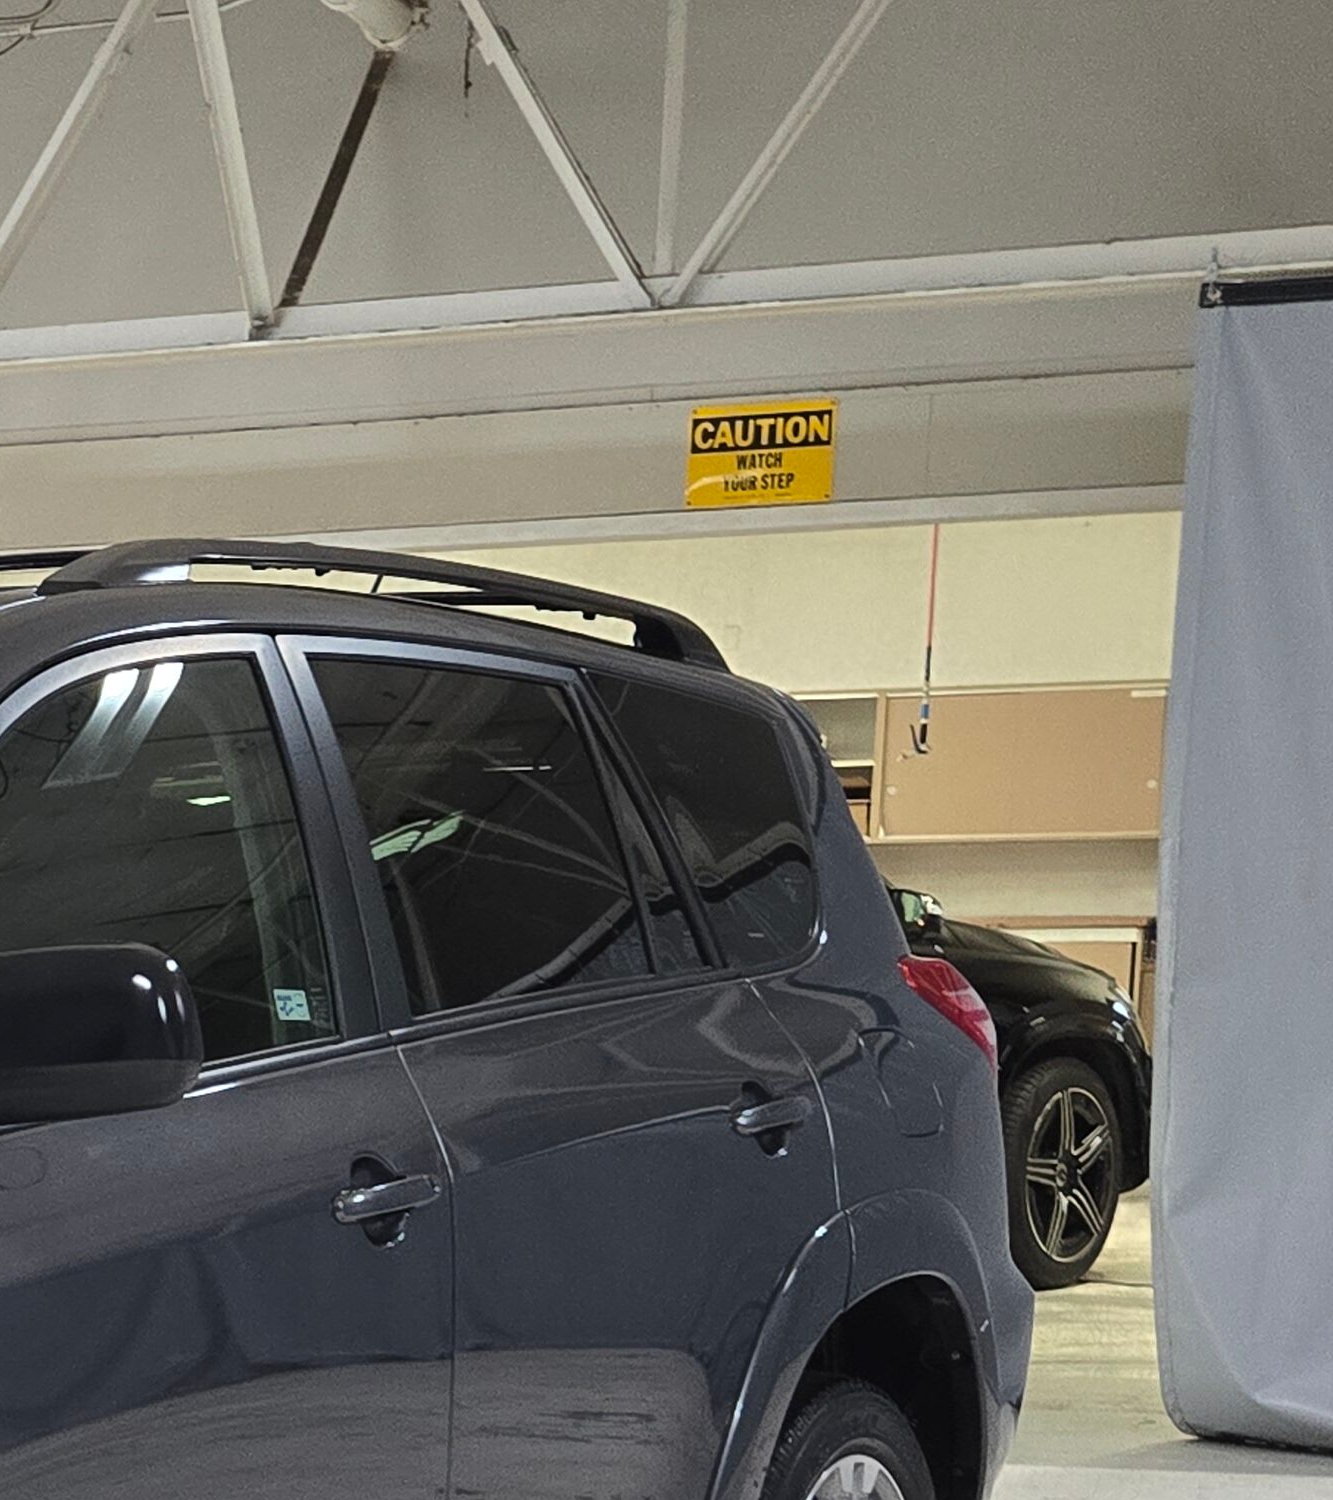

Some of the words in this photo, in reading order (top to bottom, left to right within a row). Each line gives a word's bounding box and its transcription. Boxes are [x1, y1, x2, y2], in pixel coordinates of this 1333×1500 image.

[694, 414, 830, 449] CAUTION
[736, 452, 783, 470] WATCH
[723, 474, 758, 492] YOUR
[761, 472, 795, 490] STEP
